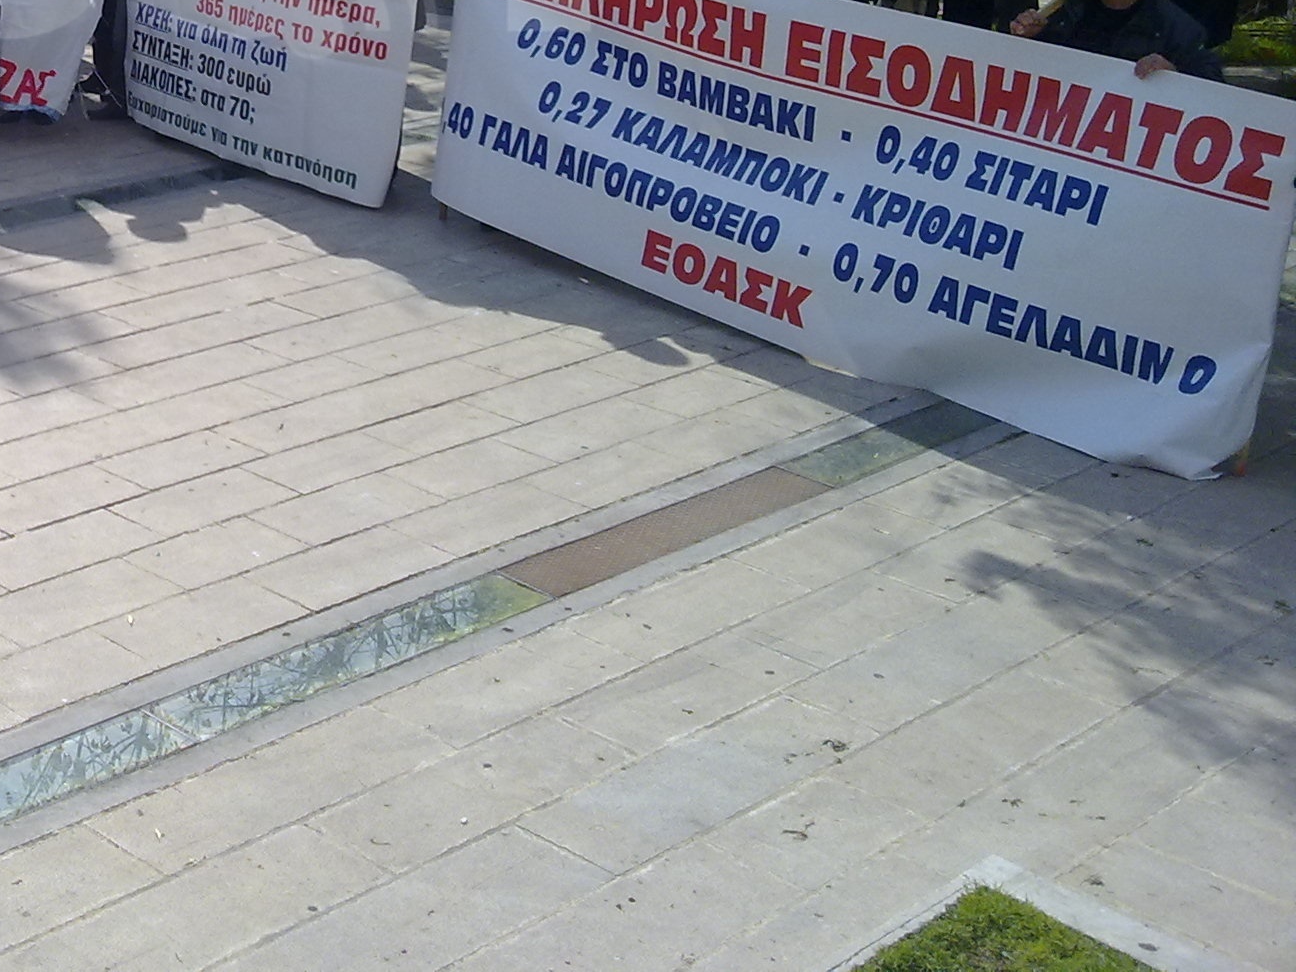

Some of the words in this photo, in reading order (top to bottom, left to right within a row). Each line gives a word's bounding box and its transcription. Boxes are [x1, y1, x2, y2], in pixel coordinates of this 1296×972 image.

[132, 30, 194, 71] ΣΥΝΤΑΞΗ:
[198, 53, 224, 80] 300
[227, 67, 271, 96] ευρώ
[177, 19, 198, 42] για
[203, 22, 227, 49] όλη
[231, 36, 247, 59] τη
[251, 39, 288, 72] ζωή
[292, 21, 313, 45] το
[321, 29, 388, 60] χρόνο
[130, 59, 197, 102] ΔΙΑΚΟΠΕΣ:
[201, 88, 224, 112] στα
[230, 95, 256, 125] 70;
[517, 18, 586, 66] 0,60
[590, 39, 648, 88] ΣΤΟ
[657, 61, 816, 143] ΒΑΜΒΑΚΙ
[876, 125, 960, 181] 0,40
[965, 151, 1110, 226] ΣΙΤΑΡΙ
[785, 20, 1286, 201] ΕΙΣΟΔΗΜΑΤΟΣ
[211, 125, 228, 147] για
[232, 135, 258, 156] την
[262, 145, 357, 189] κατανόηση
[538, 81, 612, 130] 0,27
[612, 107, 830, 205] ΚΑΛΑΜΠΟΚΙ
[851, 184, 1025, 271] ΚΡΙΘΑΡΙ
[479, 113, 548, 170] ΓΑΛΑ
[555, 145, 781, 254] ΑΙΓΟΠΡΟΒΕΙΟ
[832, 242, 920, 304] 0,70
[928, 275, 1174, 385] ΑΓΕΛΑΔΙΝ
[640, 229, 813, 328] ΕΟΑΣΚ
